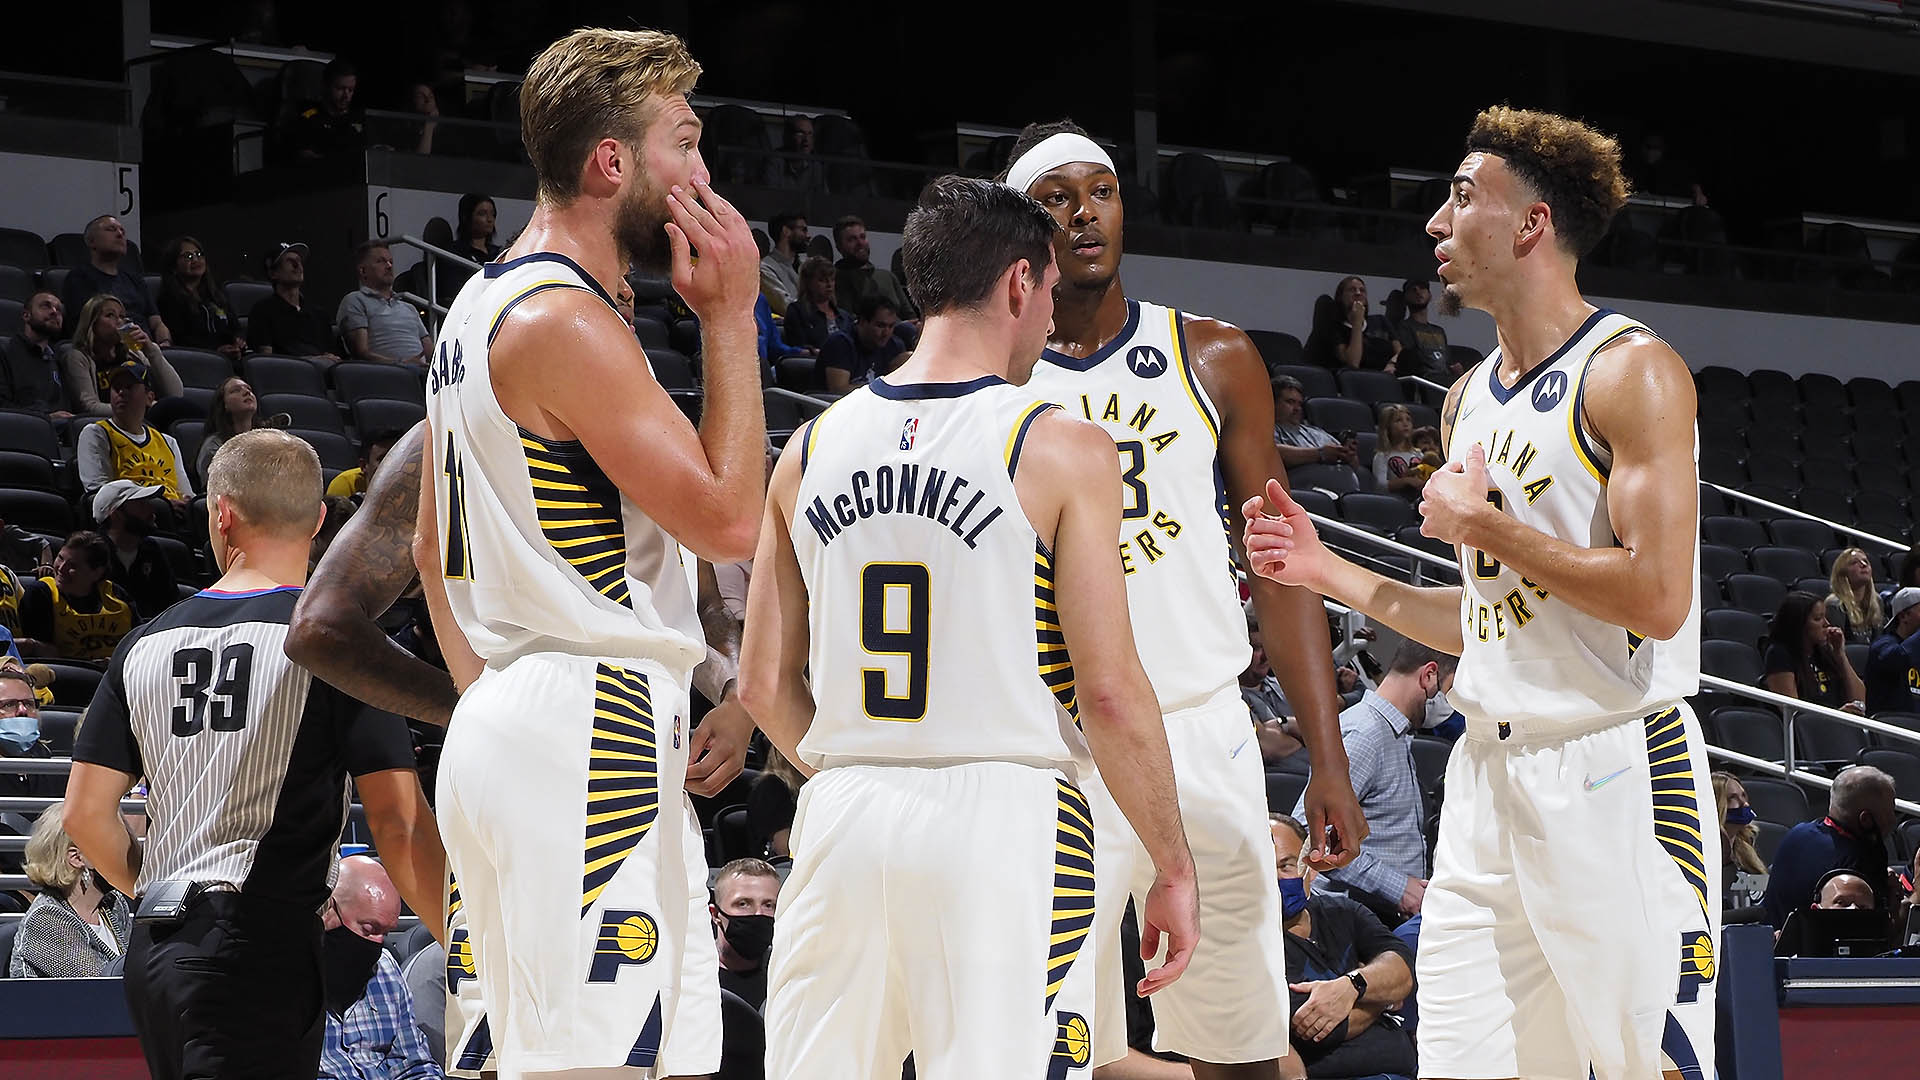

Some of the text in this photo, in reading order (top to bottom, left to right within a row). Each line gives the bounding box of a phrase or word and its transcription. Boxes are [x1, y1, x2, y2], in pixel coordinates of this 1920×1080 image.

[119, 167, 133, 216] 5
[376, 192, 389, 238] 6
[1080, 391, 1181, 455] IANA
[443, 428, 477, 584] 11
[804, 463, 1004, 551] McCONNELL
[1485, 429, 1555, 507] IANA
[1118, 509, 1184, 577] ERS
[859, 560, 932, 723] 9
[171, 642, 255, 738] 39
